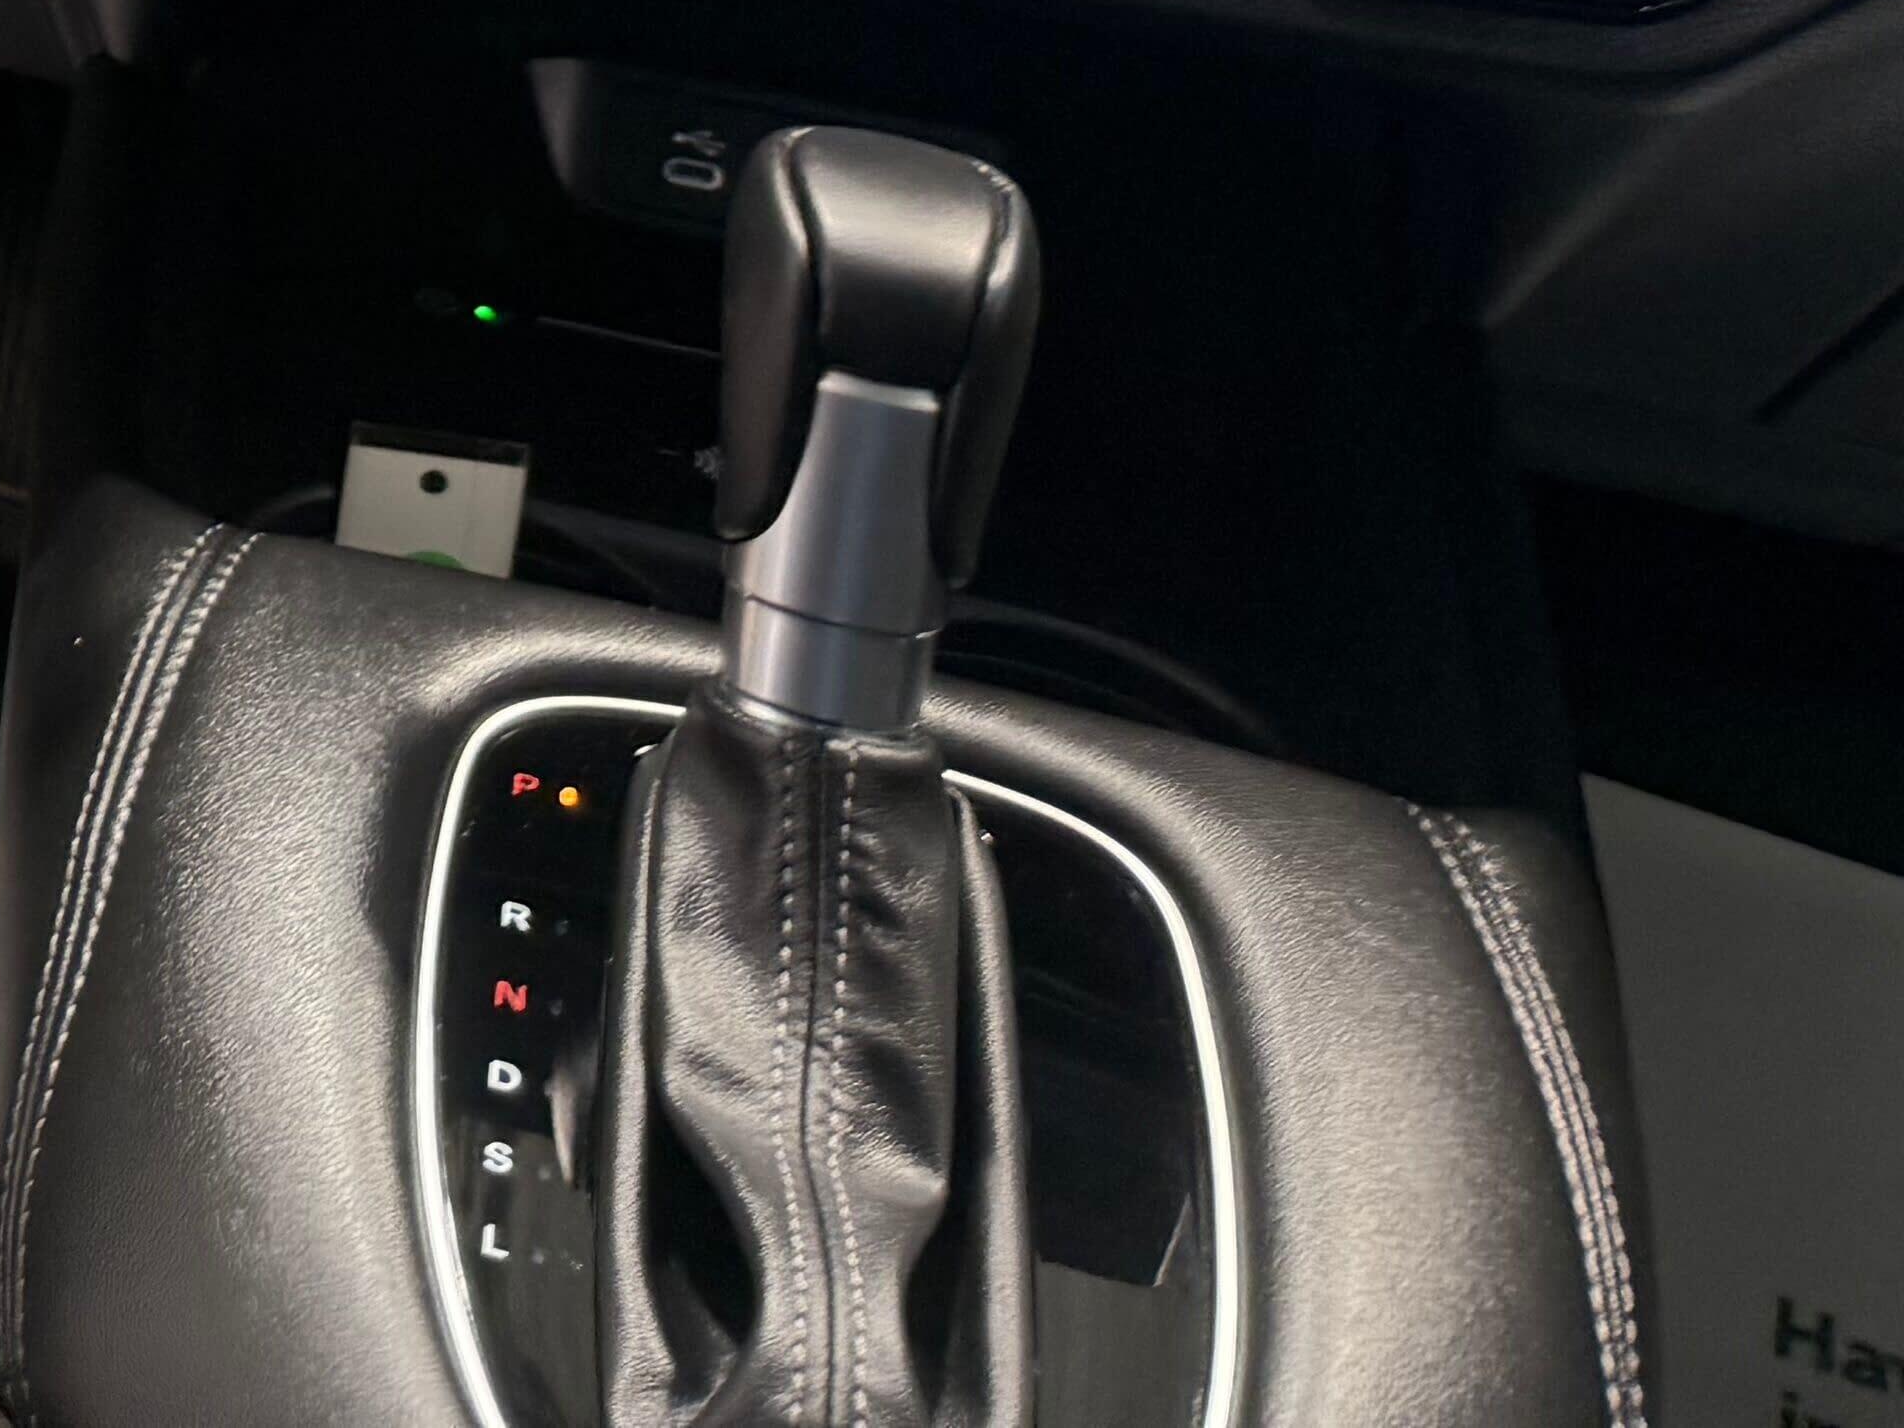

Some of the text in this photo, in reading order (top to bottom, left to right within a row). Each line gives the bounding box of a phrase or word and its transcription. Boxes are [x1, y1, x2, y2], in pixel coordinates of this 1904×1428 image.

[510, 772, 540, 797] P
[498, 900, 533, 934] R
[492, 979, 529, 1014] N
[486, 1058, 523, 1093] D
[482, 1141, 514, 1176] S
[479, 1222, 511, 1261] L
[1775, 1296, 1904, 1393] Ha
